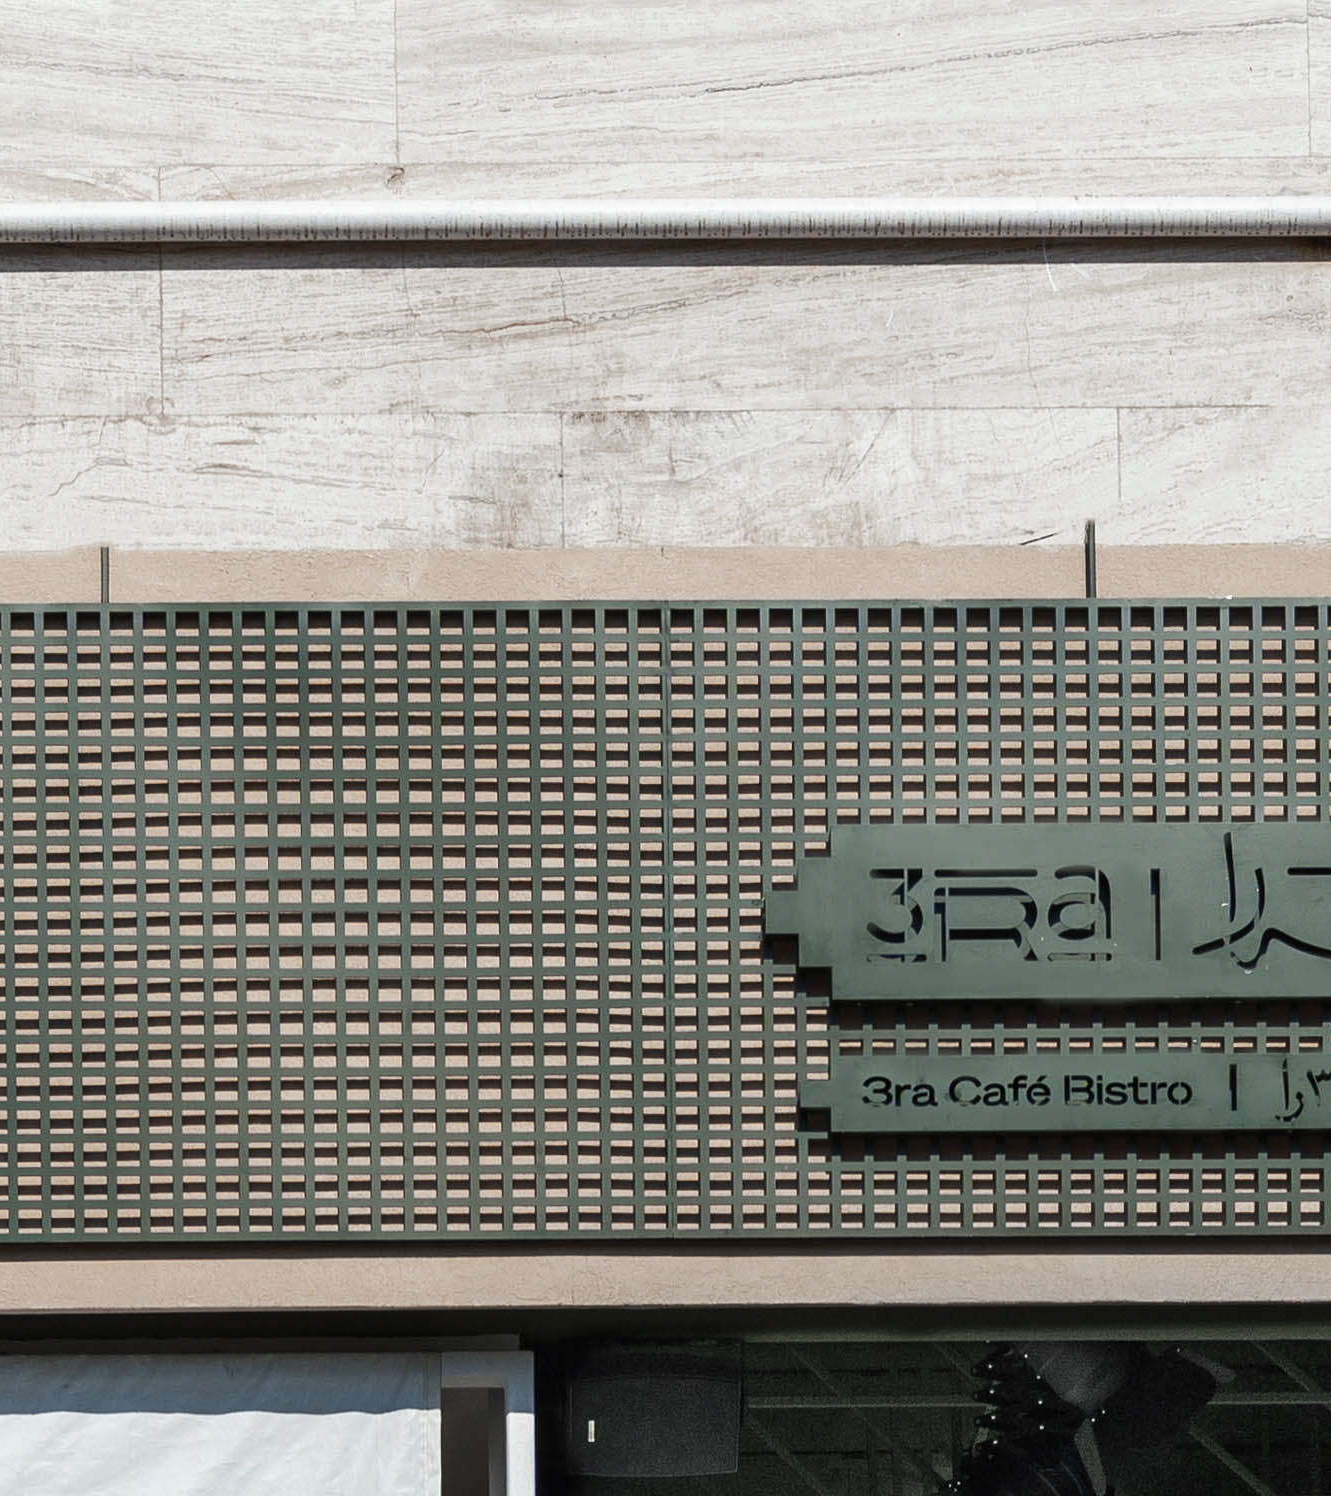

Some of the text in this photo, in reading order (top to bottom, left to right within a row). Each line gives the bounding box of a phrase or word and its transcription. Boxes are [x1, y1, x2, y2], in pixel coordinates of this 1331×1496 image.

[862, 1075, 1193, 1107] 3ra Café Bistro
